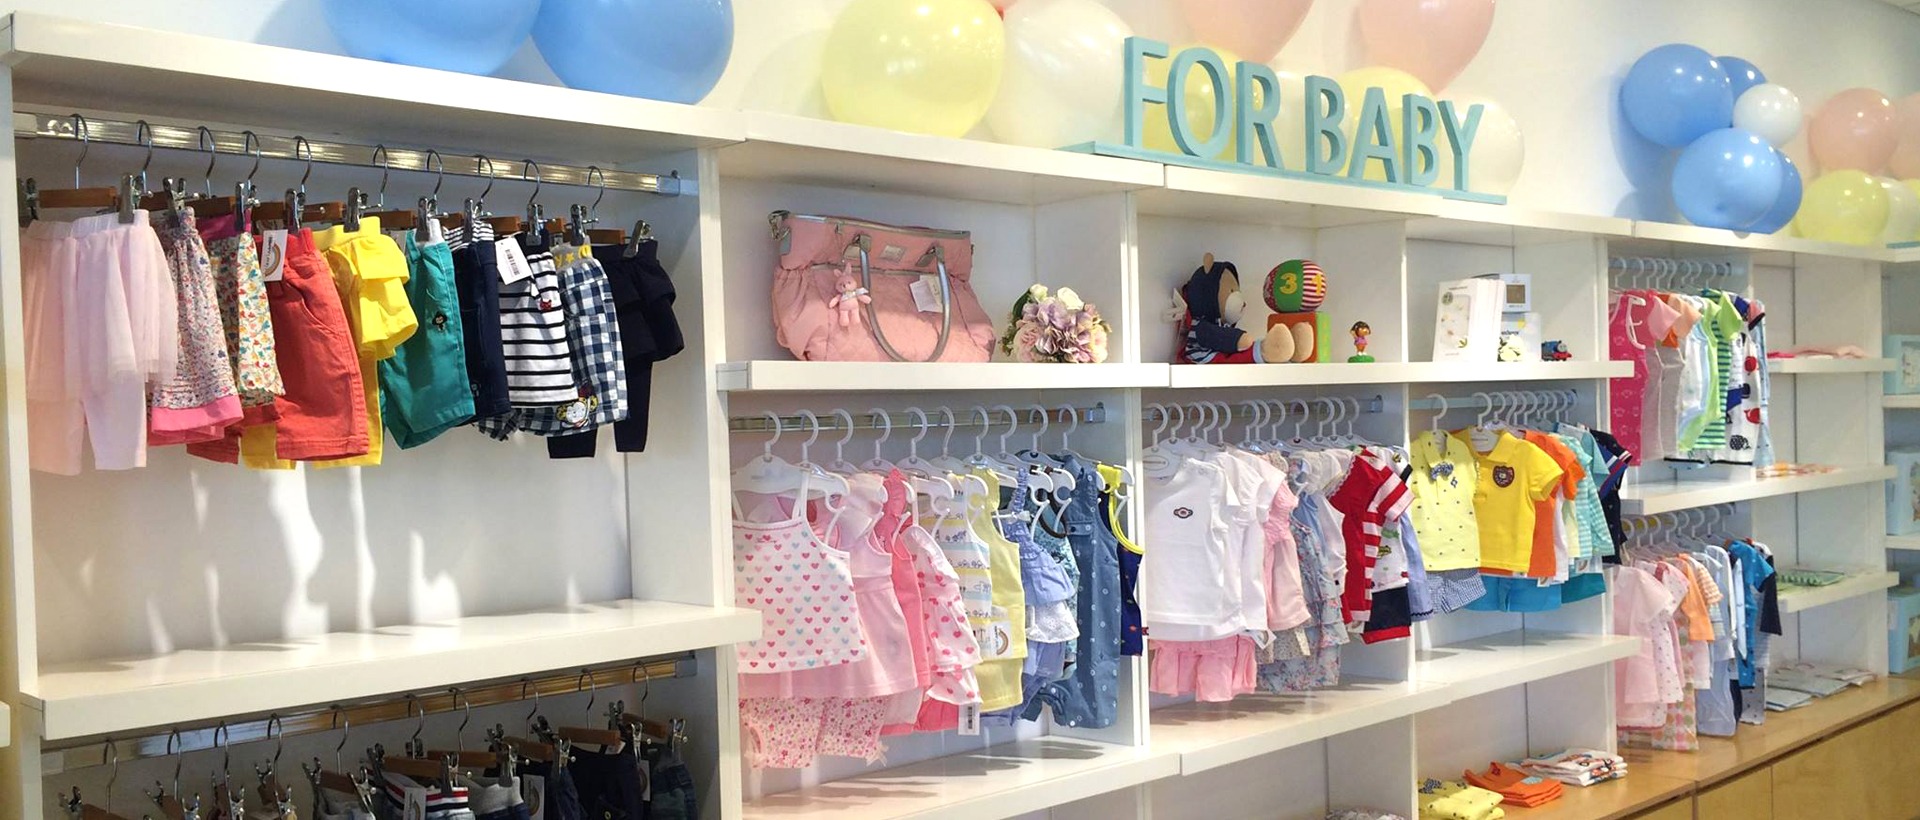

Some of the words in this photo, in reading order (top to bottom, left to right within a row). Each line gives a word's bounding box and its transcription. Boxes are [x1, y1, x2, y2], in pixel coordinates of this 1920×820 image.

[1124, 36, 1285, 170] FOR
[1305, 75, 1485, 192] BABY
[1280, 272, 1298, 295] 3
